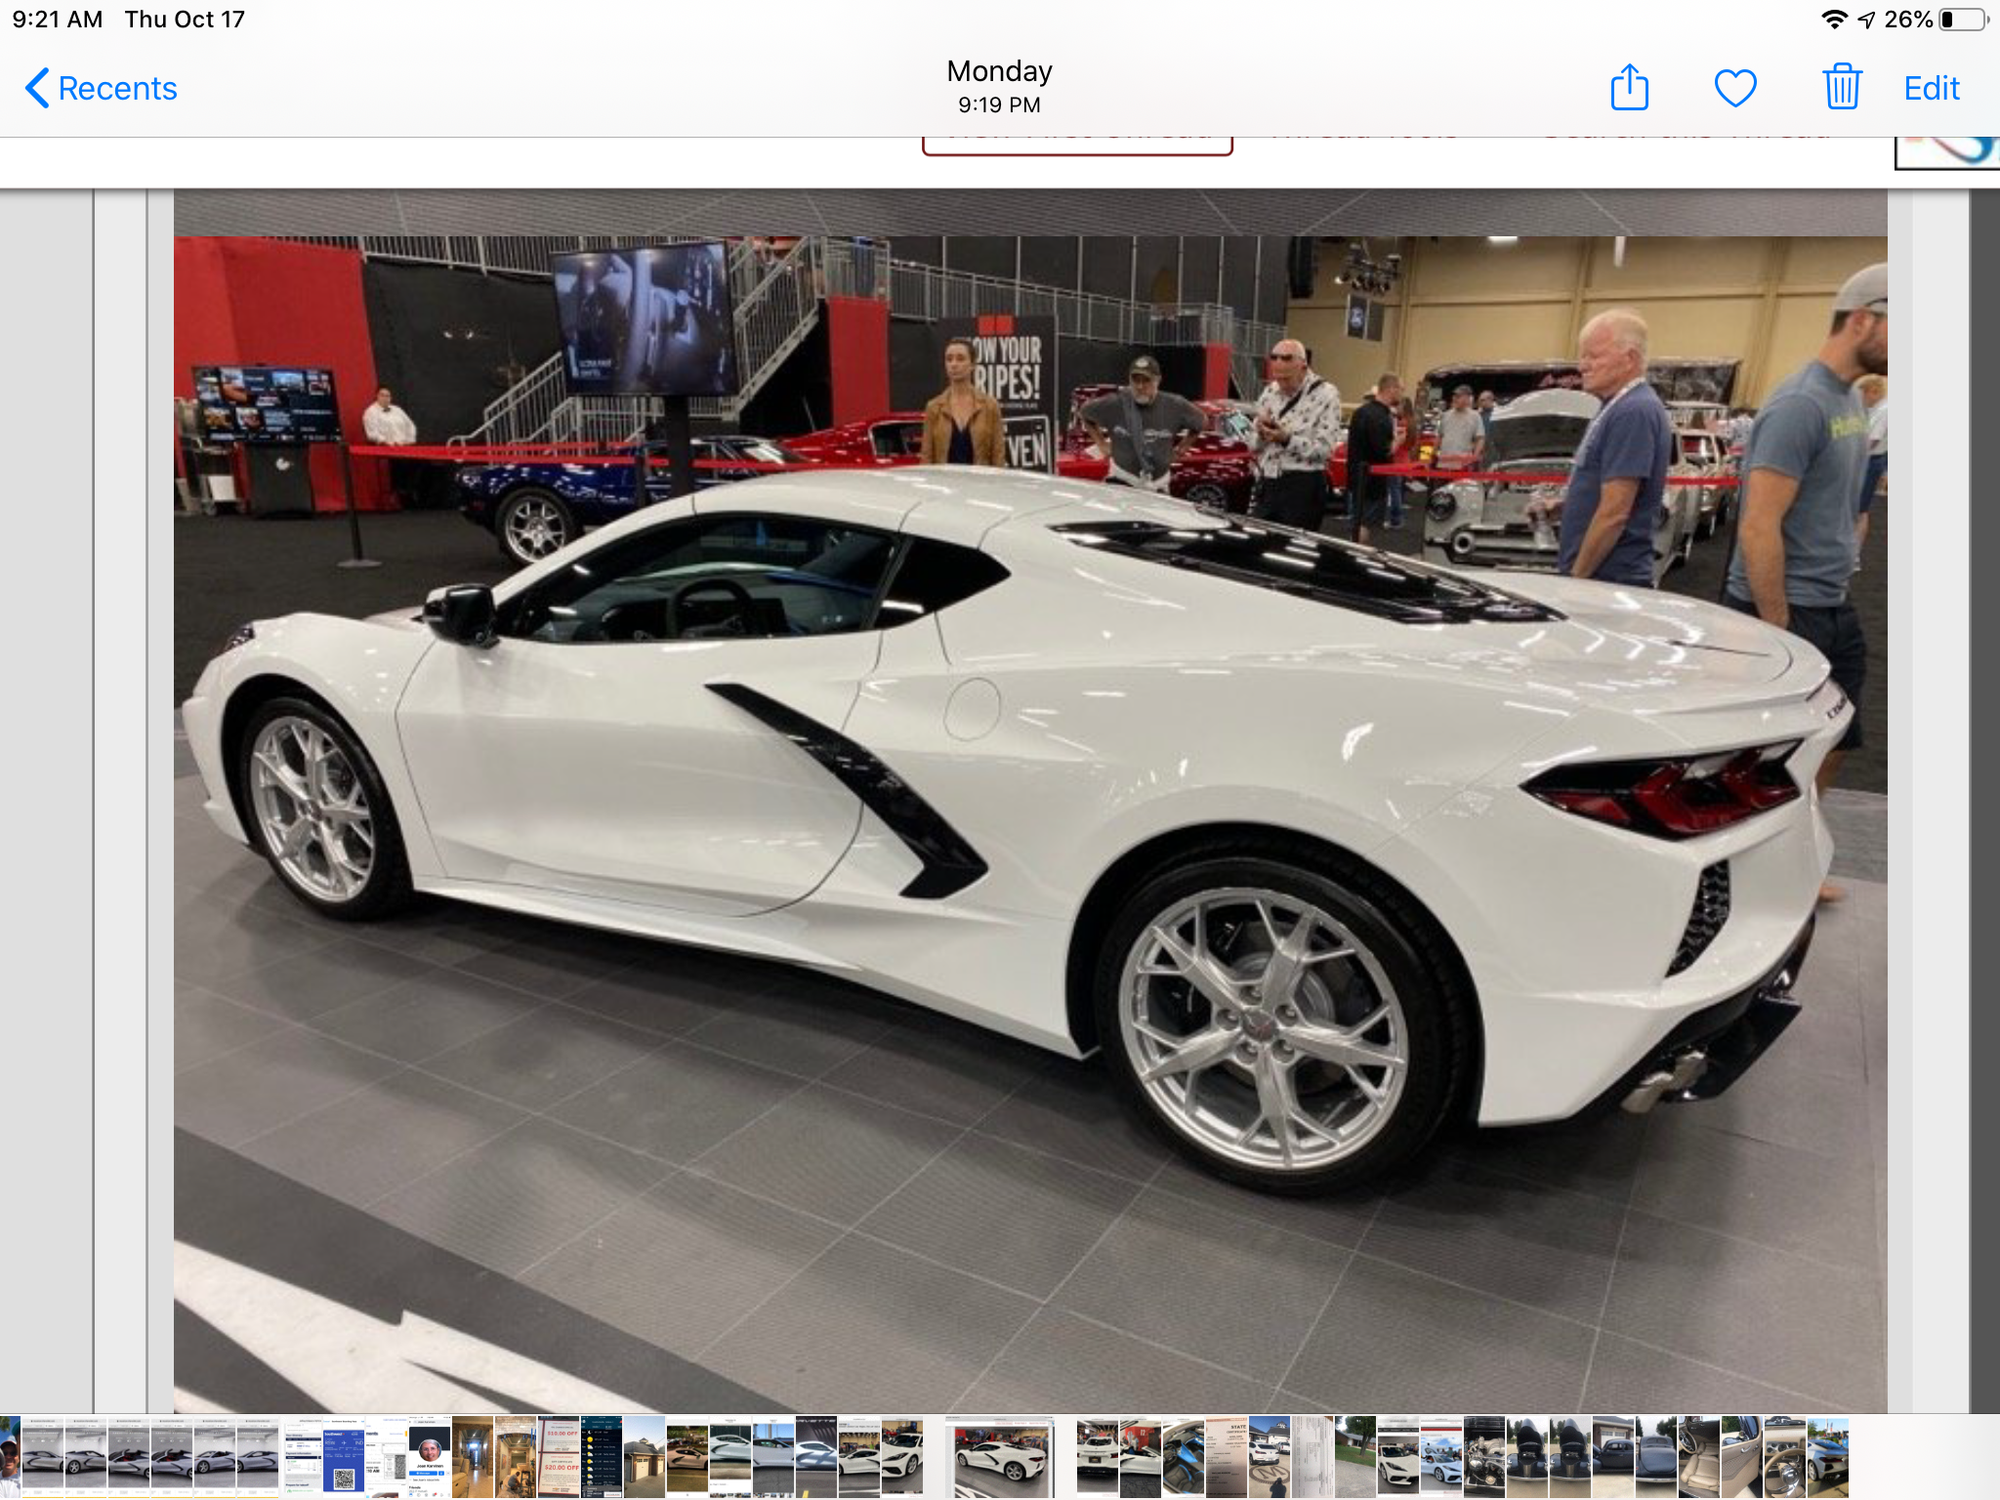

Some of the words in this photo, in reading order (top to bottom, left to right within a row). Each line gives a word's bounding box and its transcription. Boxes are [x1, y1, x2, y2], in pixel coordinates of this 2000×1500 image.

[12, 9, 58, 28] 9:21
[66, 10, 103, 28] AM
[124, 9, 167, 28] Thu
[174, 9, 215, 28] Oct
[221, 10, 245, 28] 17
[1885, 9, 1934, 29] 26%
[948, 58, 1053, 88] Monday
[59, 75, 178, 101] Recents
[1905, 74, 1961, 101] Edit
[958, 96, 1002, 114] 9:19
[1010, 96, 1040, 114] PM
[971, 335, 998, 364] OW
[999, 335, 1042, 364] YOUR
[974, 363, 1041, 400] RIPES!
[1005, 432, 1047, 467] VEN
